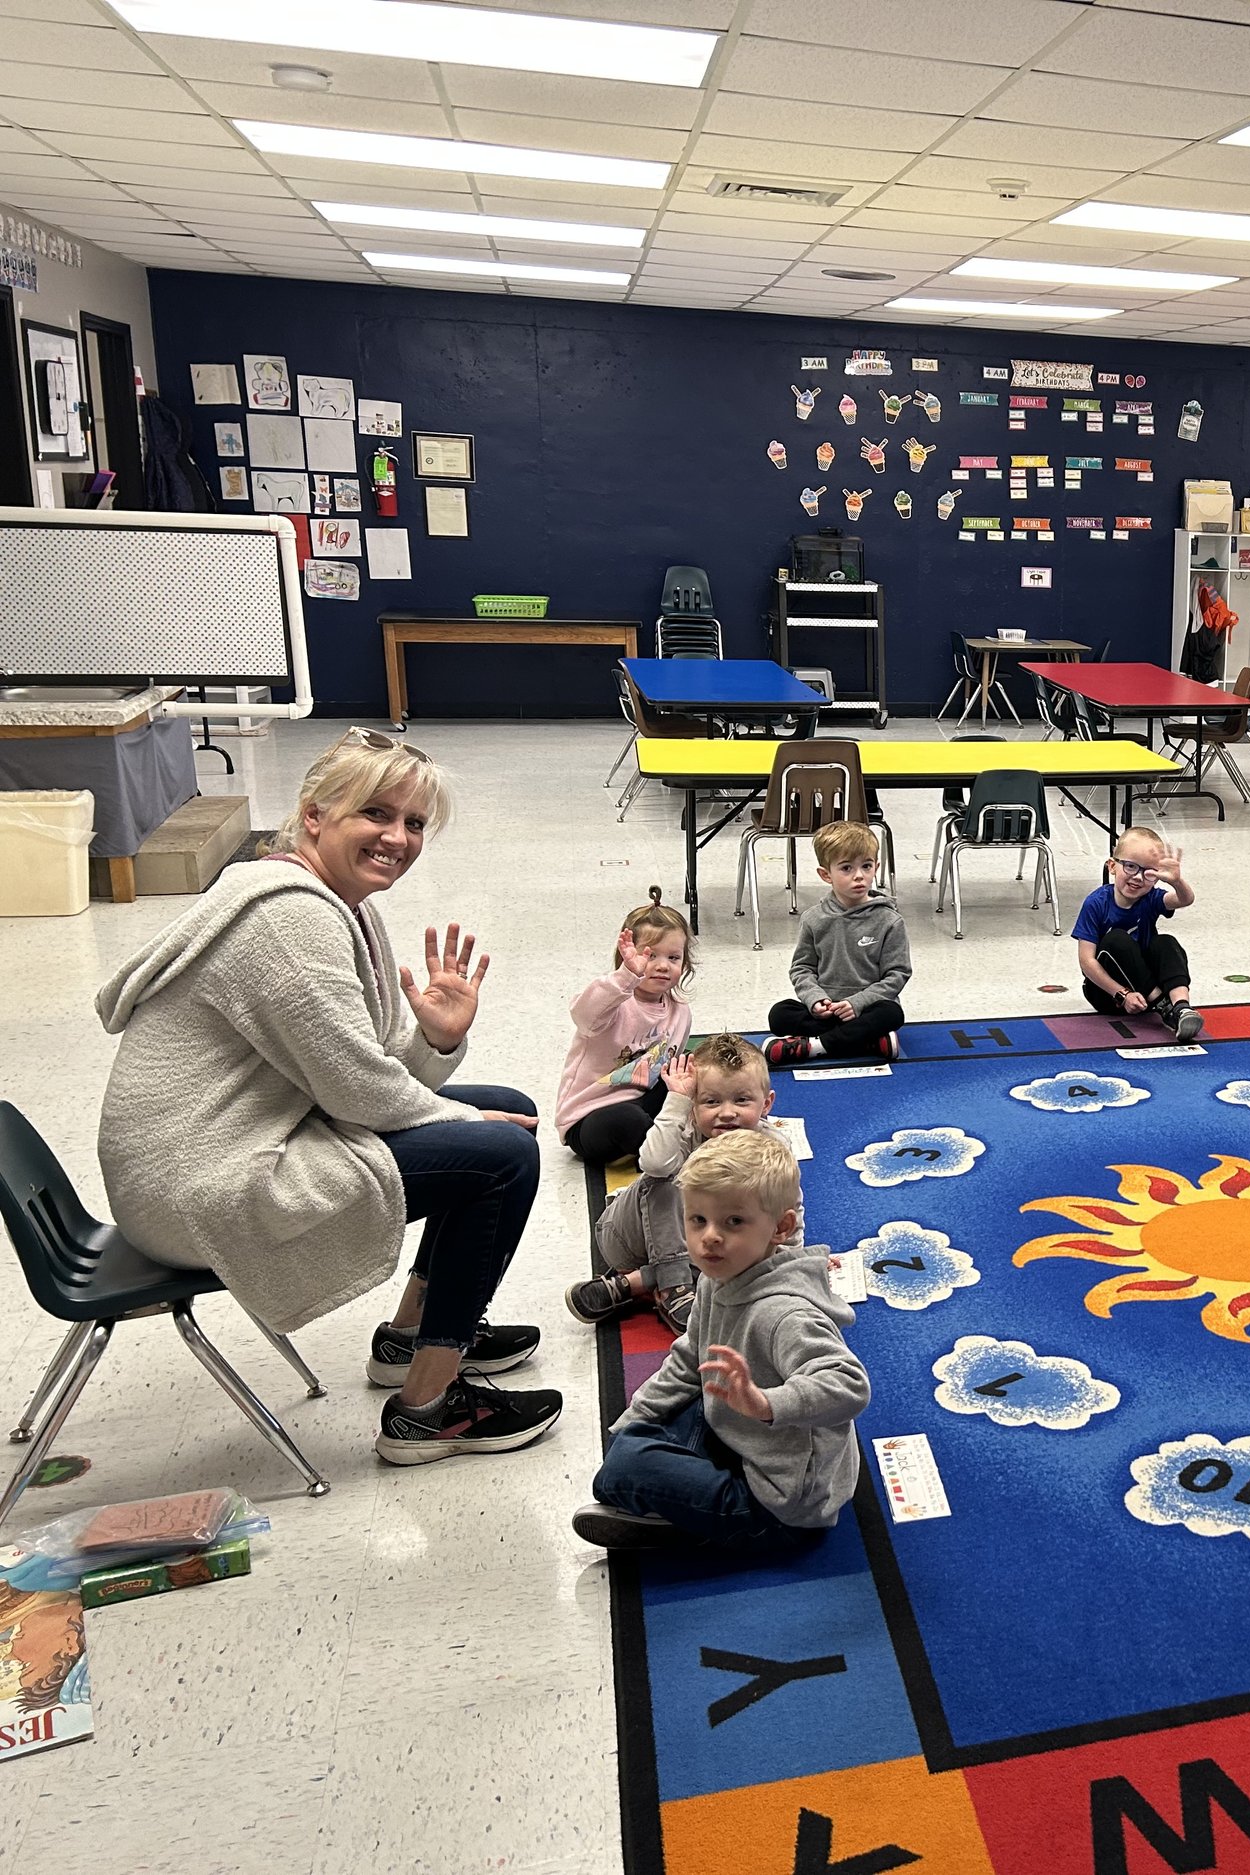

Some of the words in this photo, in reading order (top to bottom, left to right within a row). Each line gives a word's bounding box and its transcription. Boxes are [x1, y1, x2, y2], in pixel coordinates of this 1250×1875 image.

[853, 350, 886, 360] HAPPY
[993, 370, 1007, 378] AM
[1021, 367, 1040, 379] Let's
[1041, 367, 1085, 380] Celebrate
[1105, 374, 1118, 383] PM
[1035, 378, 1070, 387] BIRTHDAYS
[1124, 461, 1142, 469] AUGUST
[968, 519, 993, 527] SEPTEMBER
[1021, 520, 1041, 528] OCTOBER
[1108, 1021, 1137, 1039] I
[950, 1028, 1015, 1050] H
[1068, 1085, 1098, 1097] 4
[893, 1147, 942, 1162] 3
[871, 1255, 926, 1275] 2
[974, 1372, 1026, 1398] 1
[895, 1451, 917, 1472] Jack
[700, 1645, 847, 1729] Y
